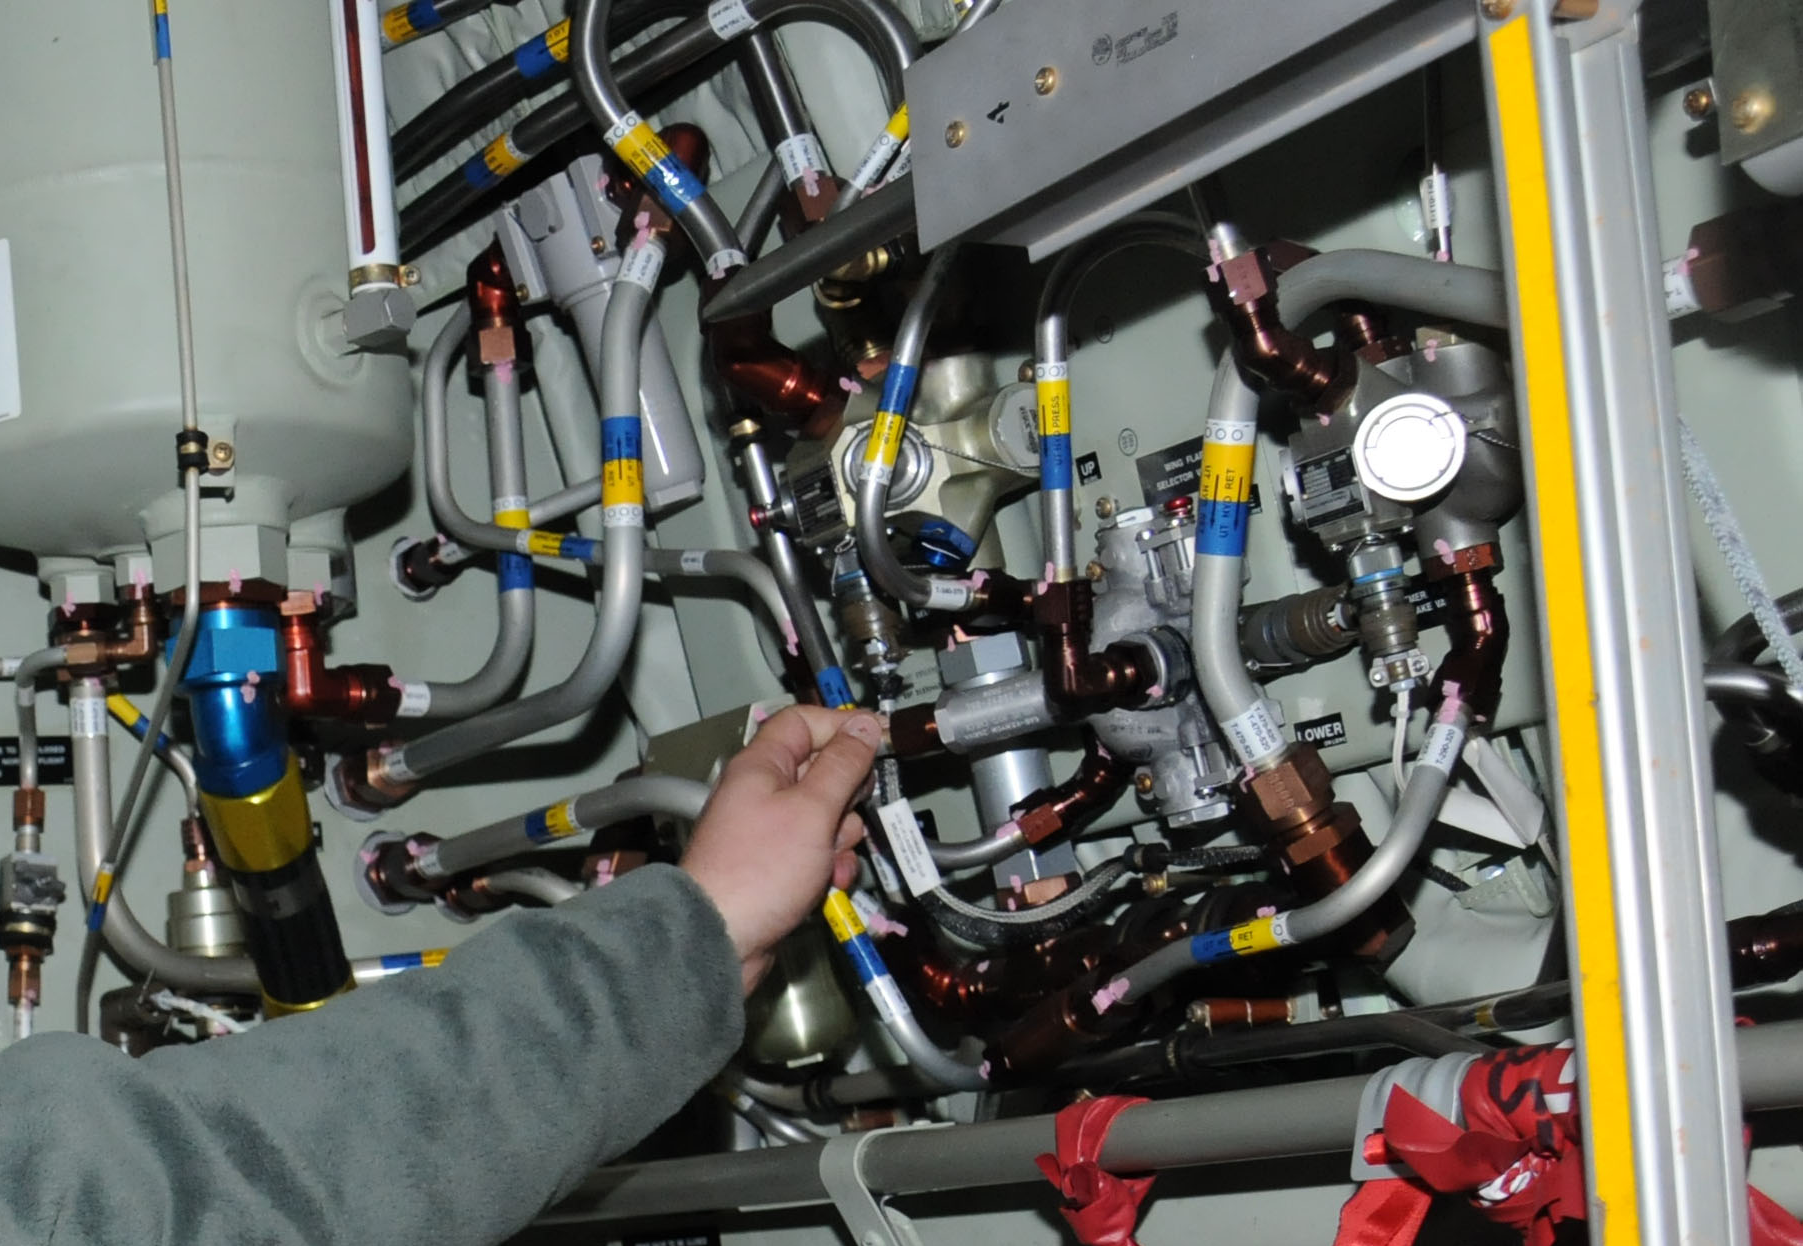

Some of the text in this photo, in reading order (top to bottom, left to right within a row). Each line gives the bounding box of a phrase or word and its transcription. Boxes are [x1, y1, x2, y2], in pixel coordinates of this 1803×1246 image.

[1052, 395, 1061, 428] PRESS
[1081, 461, 1095, 476] UP
[1157, 471, 1194, 491] SELECTOR
[1224, 469, 1235, 489] RET
[1238, 931, 1253, 941] RET
